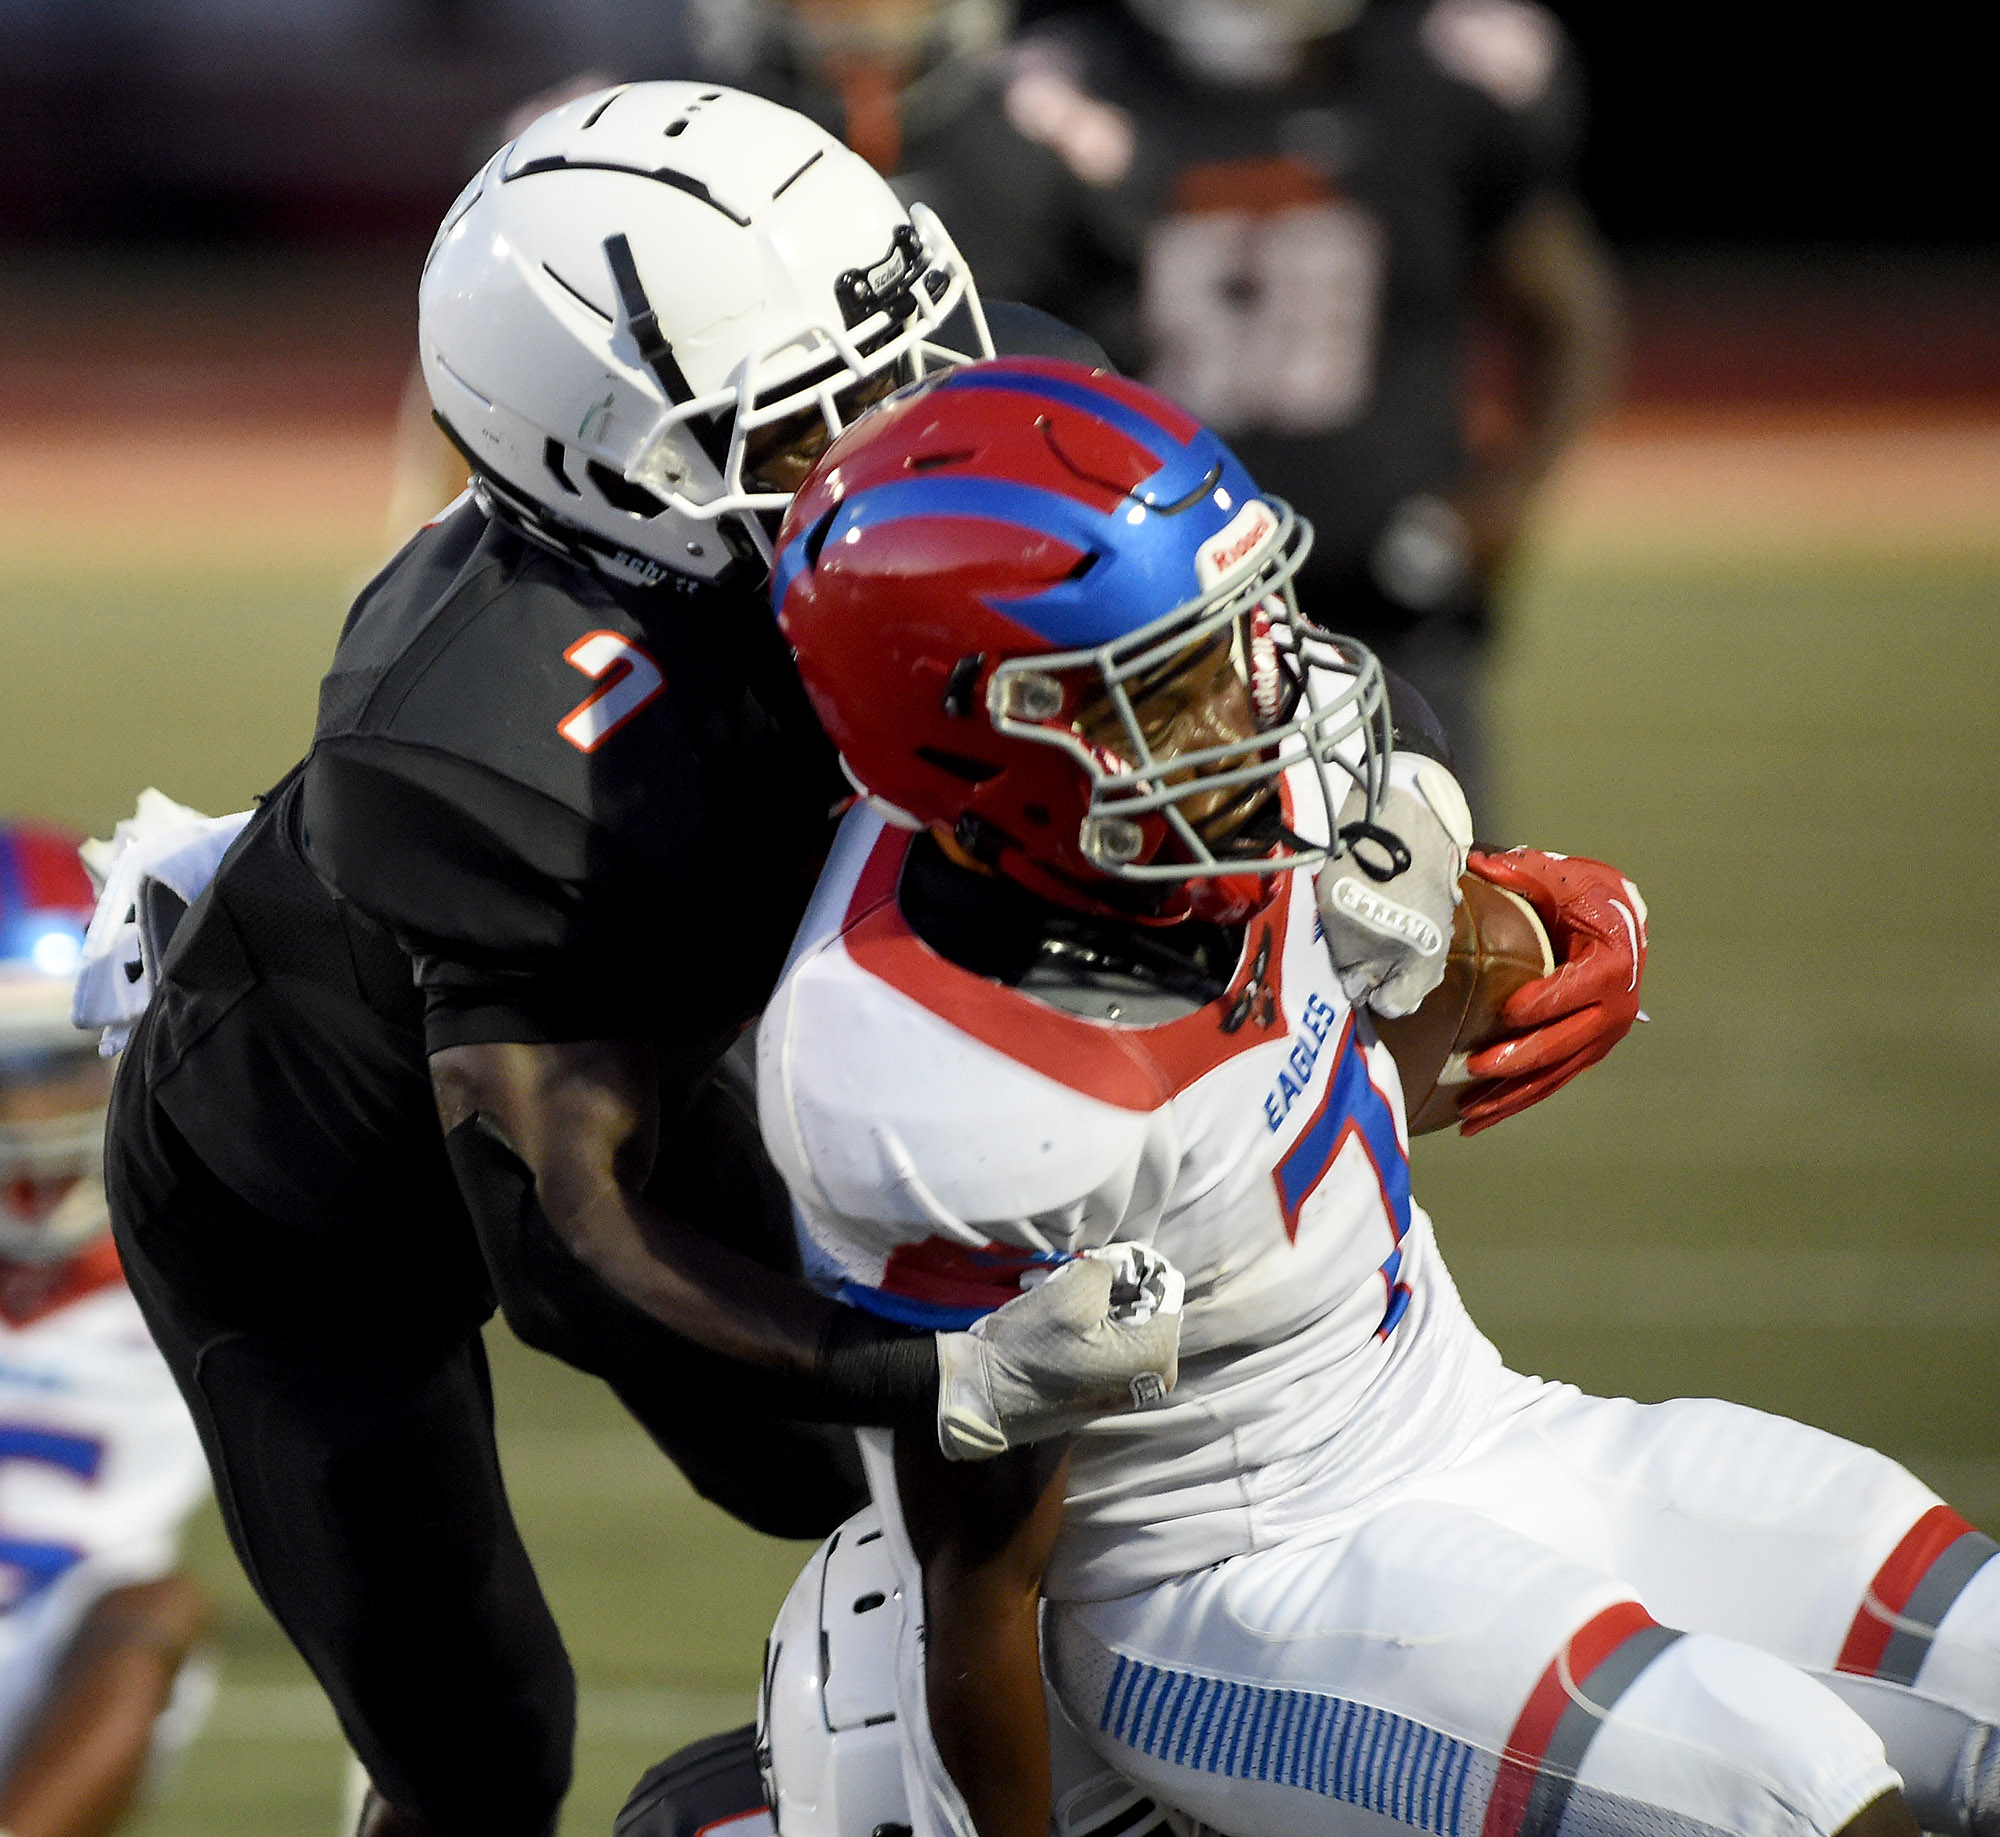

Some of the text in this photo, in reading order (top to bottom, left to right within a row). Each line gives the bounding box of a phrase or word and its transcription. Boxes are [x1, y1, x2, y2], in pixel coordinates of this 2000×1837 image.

[556, 628, 668, 755] 7
[1262, 991, 1337, 1134] EAGLES
[1270, 1004, 1413, 1345] 7
